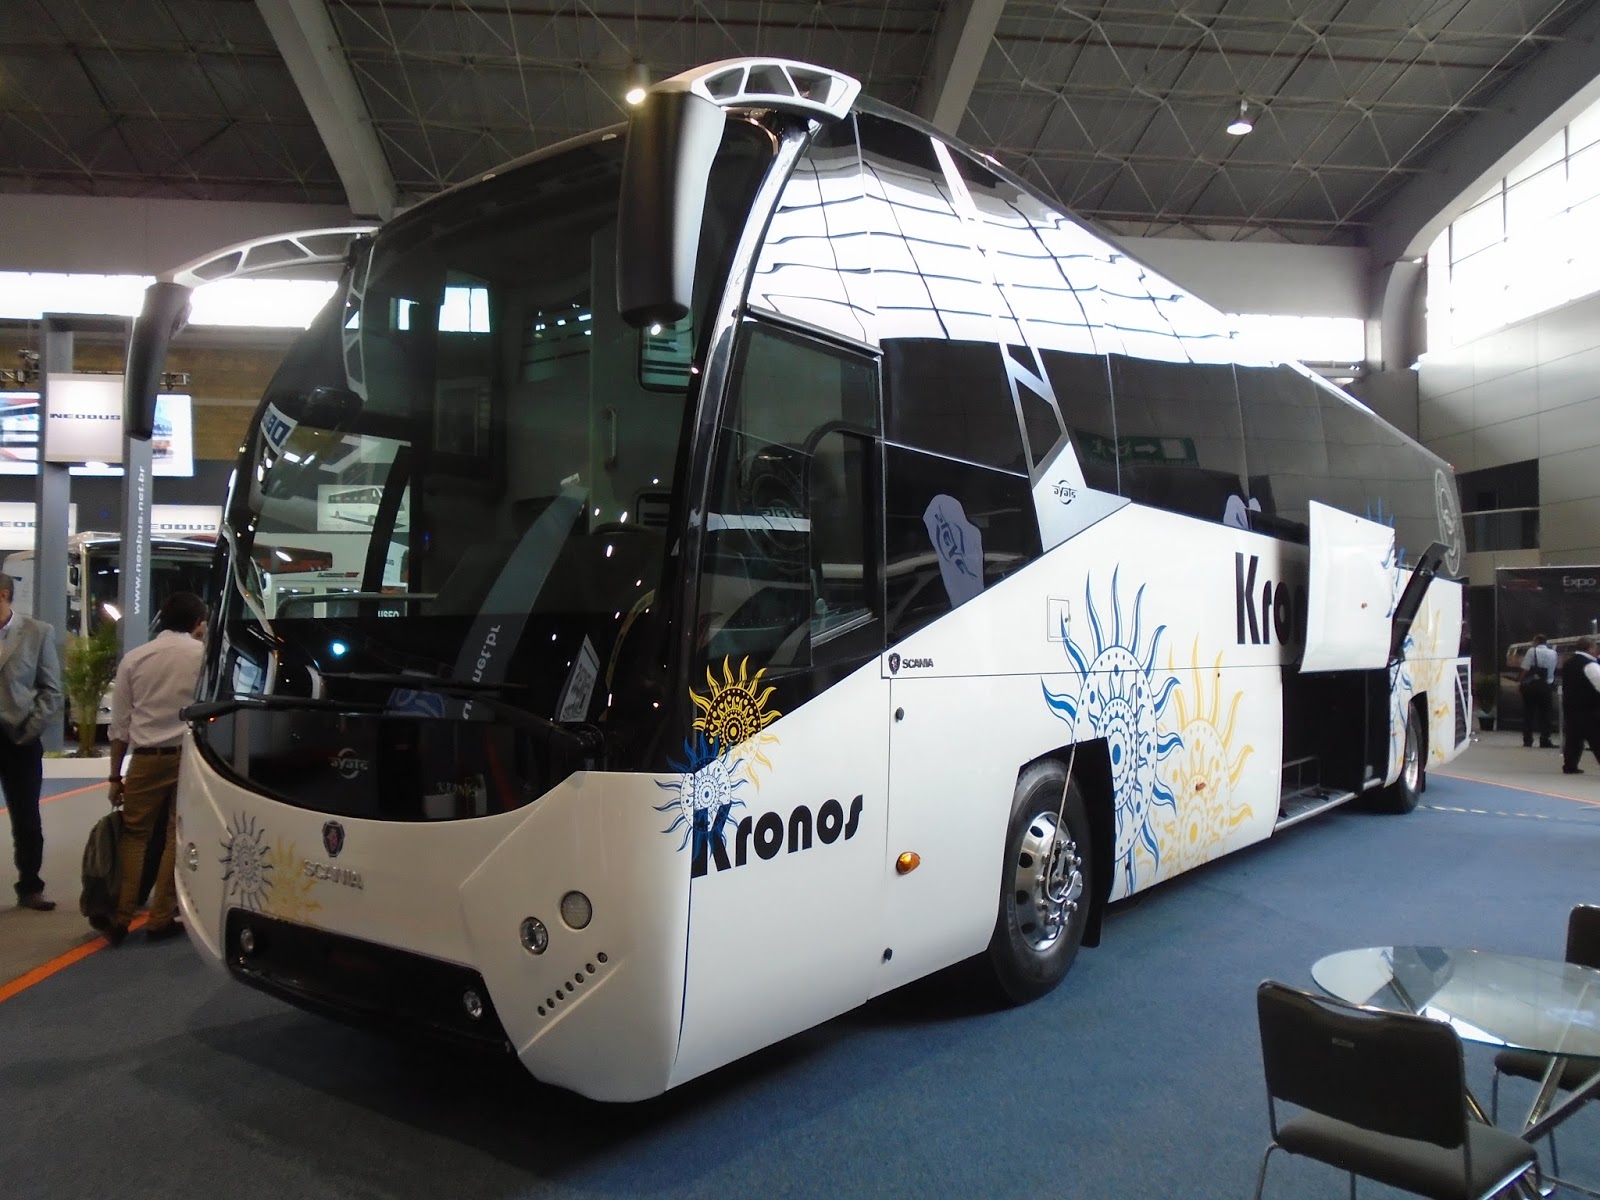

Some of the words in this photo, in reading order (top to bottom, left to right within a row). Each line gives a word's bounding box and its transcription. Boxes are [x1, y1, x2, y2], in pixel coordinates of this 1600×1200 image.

[50, 413, 121, 421] NEOBUS
[134, 465, 146, 615] www.neobus.net.br
[902, 658, 934, 669] SCANIA
[691, 794, 863, 879] Kronos
[303, 860, 363, 891] SCANIA
